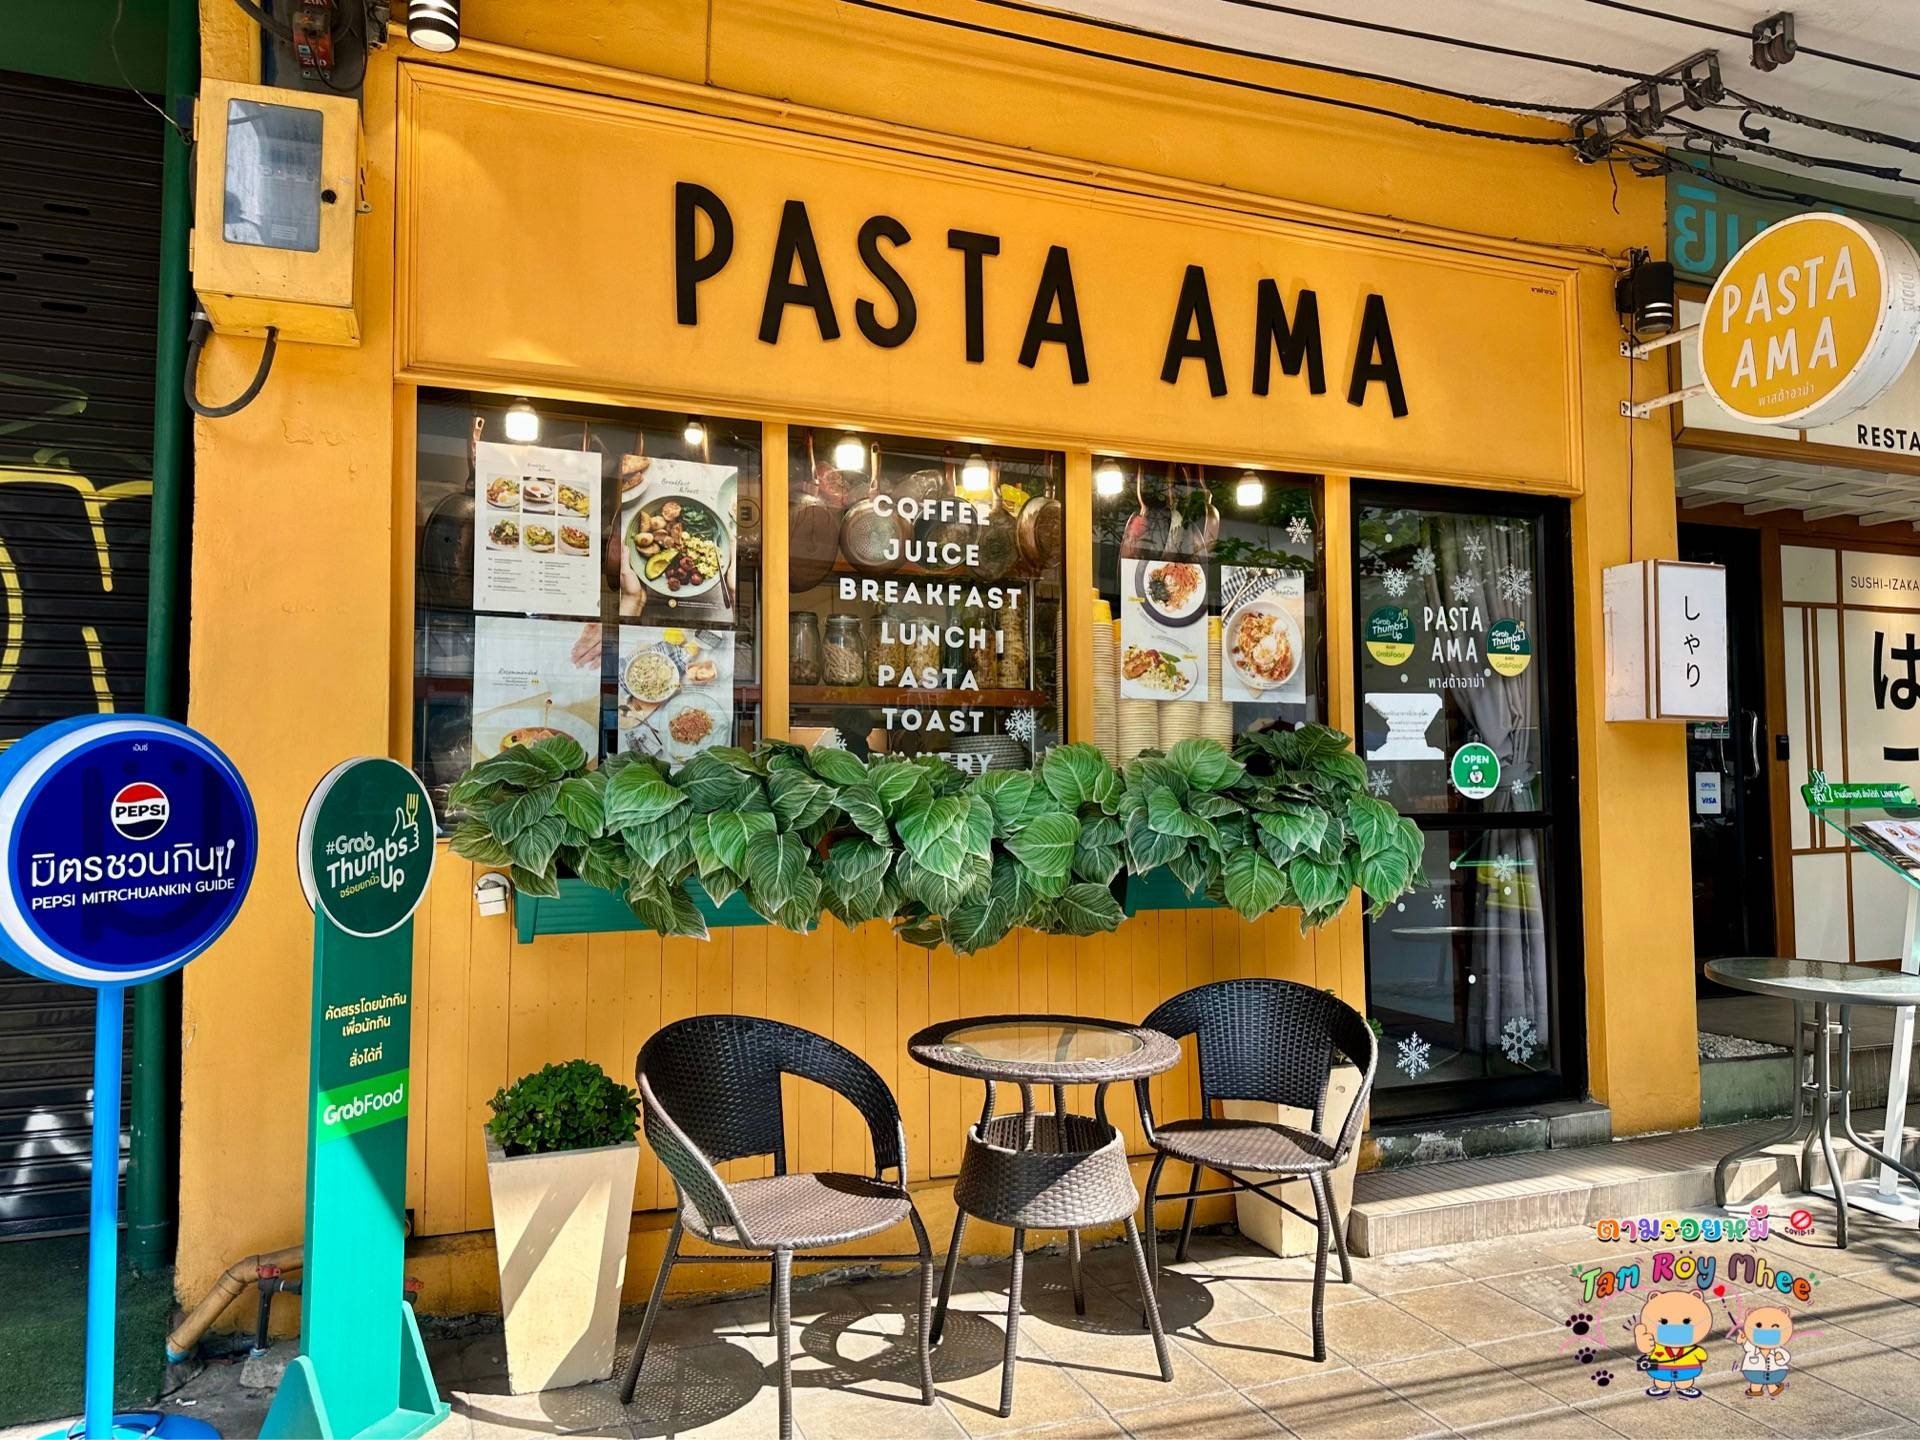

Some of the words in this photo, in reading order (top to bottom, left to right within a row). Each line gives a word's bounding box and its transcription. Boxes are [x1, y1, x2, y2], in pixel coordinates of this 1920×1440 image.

[674, 181, 1090, 386] PASTA
[1160, 264, 1408, 418] AMA
[1721, 245, 1857, 334] PASTA
[1731, 316, 1839, 389] AMA
[1857, 424, 1920, 452] RESTA
[873, 494, 990, 526] COFFEE
[883, 538, 980, 567] JUICE
[839, 577, 1022, 610] BREAKFAST
[1372, 622, 1404, 635] Thumbs
[1423, 605, 1483, 633] PASTA
[880, 622, 987, 650] LUNCH
[1431, 636, 1478, 664] AMA
[1491, 634, 1521, 647] Thumbs
[1684, 595, 1700, 687] しゃり
[878, 664, 980, 692] PASTA
[1428, 673, 1485, 688] พาสต้าอาม่า
[881, 708, 984, 733] TOAST
[1462, 755, 1489, 765] OPEN
[115, 804, 166, 818] PEPSI
[1702, 797, 1717, 805] VISA
[325, 831, 375, 855] #Grab
[326, 837, 408, 888] Thumbs
[381, 864, 405, 893] Up
[32, 894, 76, 910] PEPSI
[82, 883, 191, 905] MITRCHUANKIN
[195, 878, 235, 893] GUIDE
[325, 992, 407, 1020] คัดสรรโดยนักกิน
[342, 1015, 391, 1037] เพื่อนักกิน
[349, 1042, 383, 1068] สั่งได้ที่
[323, 1083, 404, 1126] GrabFood
